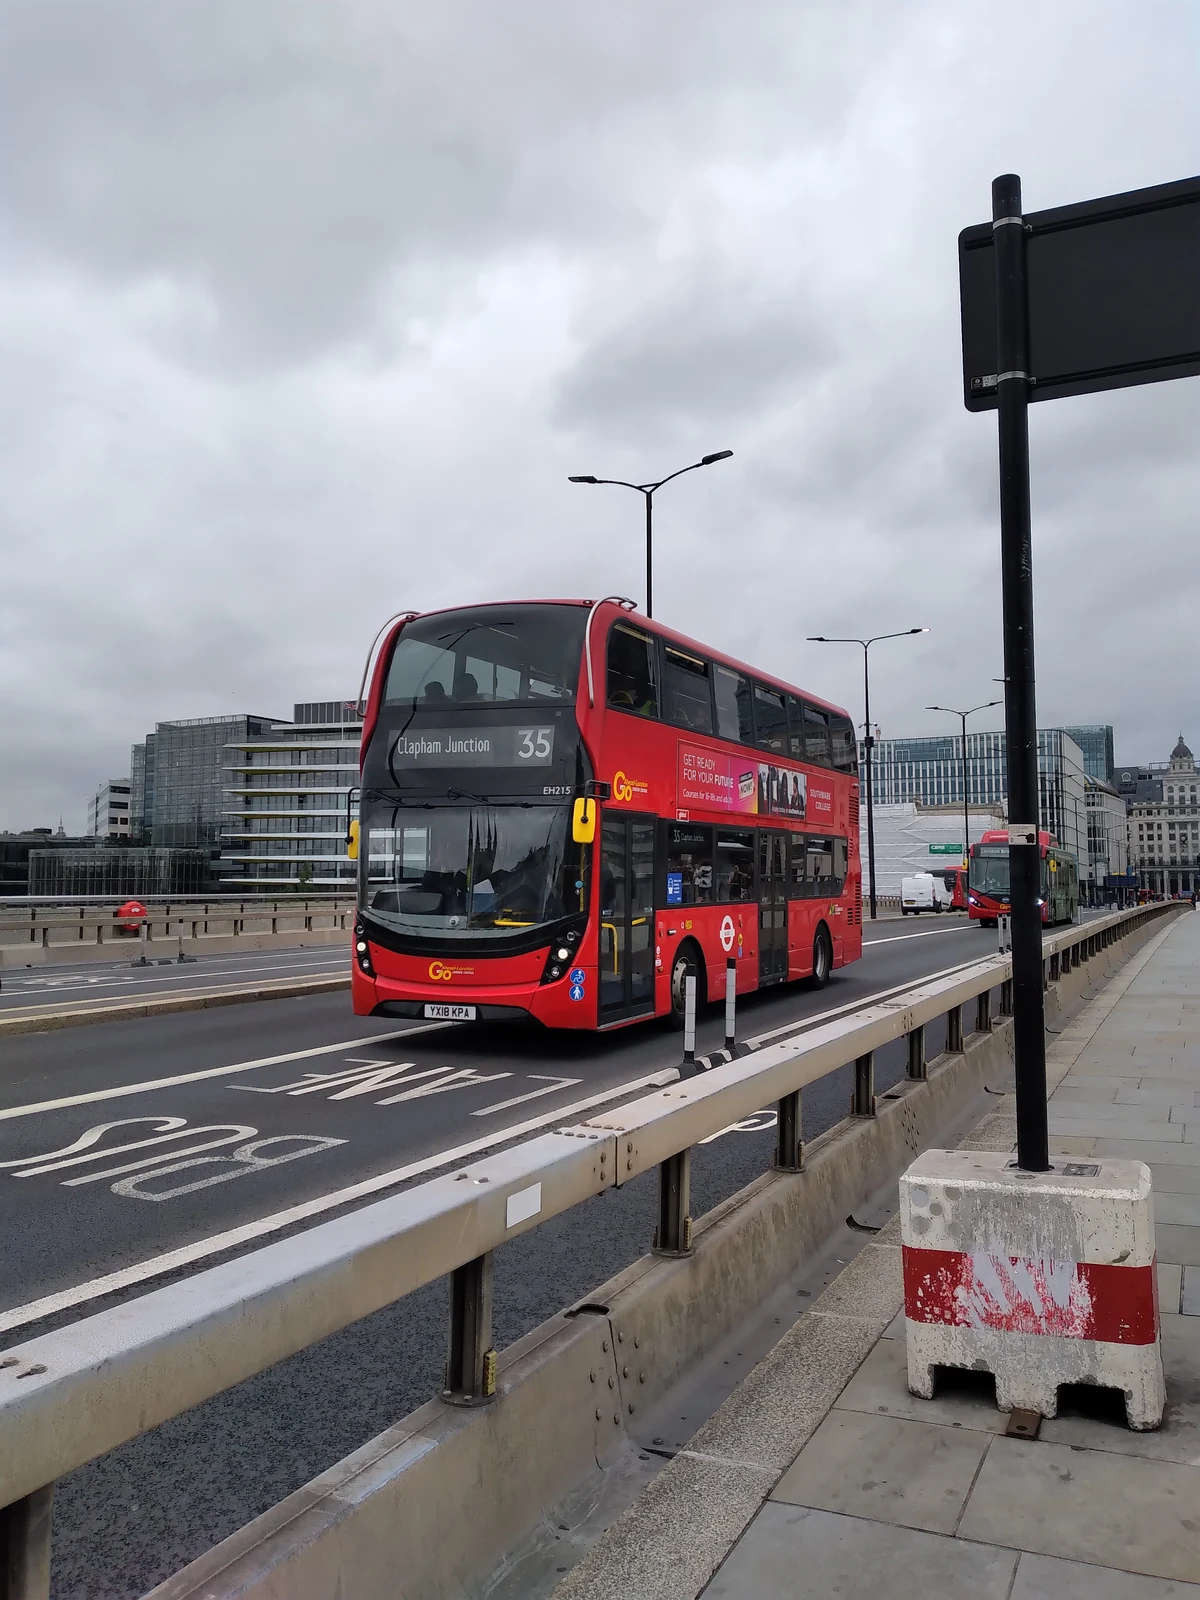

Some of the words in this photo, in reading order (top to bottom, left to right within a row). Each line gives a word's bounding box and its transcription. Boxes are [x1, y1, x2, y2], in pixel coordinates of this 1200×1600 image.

[397, 737, 441, 759] Clapham
[445, 736, 490, 753] Junction
[518, 729, 551, 758] 35
[683, 753, 696, 766] GET
[697, 756, 715, 770] READY
[613, 771, 632, 801] Go
[683, 768, 697, 781] FOR
[698, 771, 714, 785] YOUR
[714, 774, 734, 788] FUTURE
[543, 786, 571, 795] EH215
[682, 788, 699, 799] Courses
[810, 788, 831, 801] SOUTHWARK
[815, 801, 832, 812] COLLEGE
[673, 829, 681, 843] 35
[429, 961, 452, 981] Go
[430, 1006, 450, 1017] YX18
[452, 1007, 470, 1018] KPA
[224, 1058, 584, 1117] LANE
[0, 1116, 350, 1201] BUS
